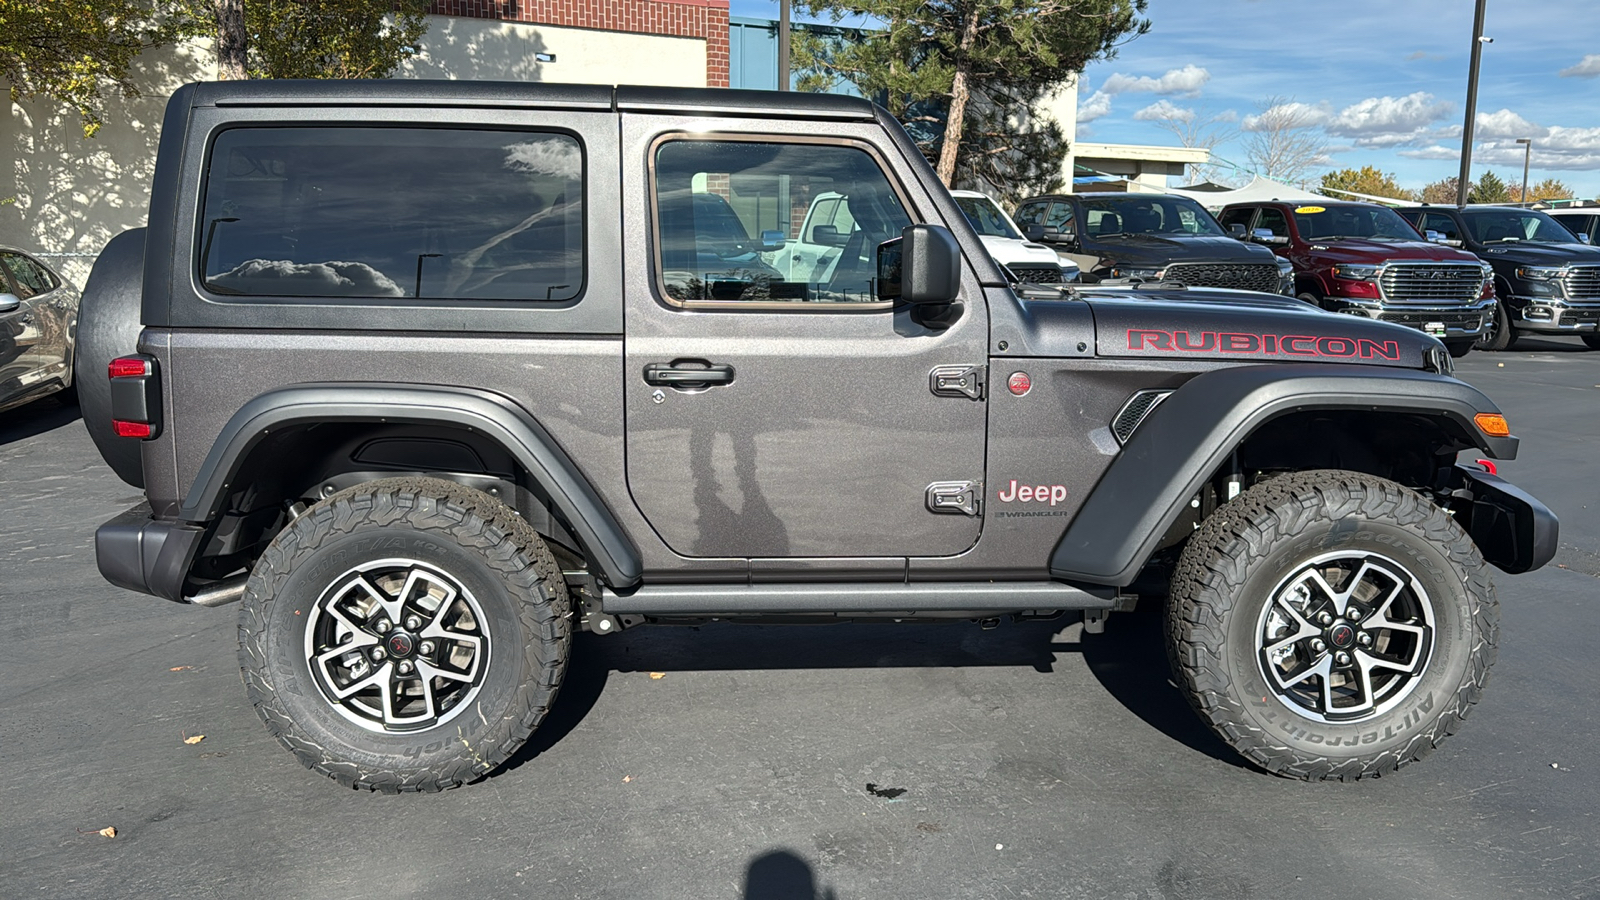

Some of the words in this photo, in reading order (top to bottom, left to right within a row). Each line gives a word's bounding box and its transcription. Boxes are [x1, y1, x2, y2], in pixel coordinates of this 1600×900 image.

[1412, 271, 1462, 279] RAM
[1127, 329, 1399, 360] RUBICON
[997, 479, 1067, 506] Jeep
[1279, 690, 1435, 747] All-Terrain
